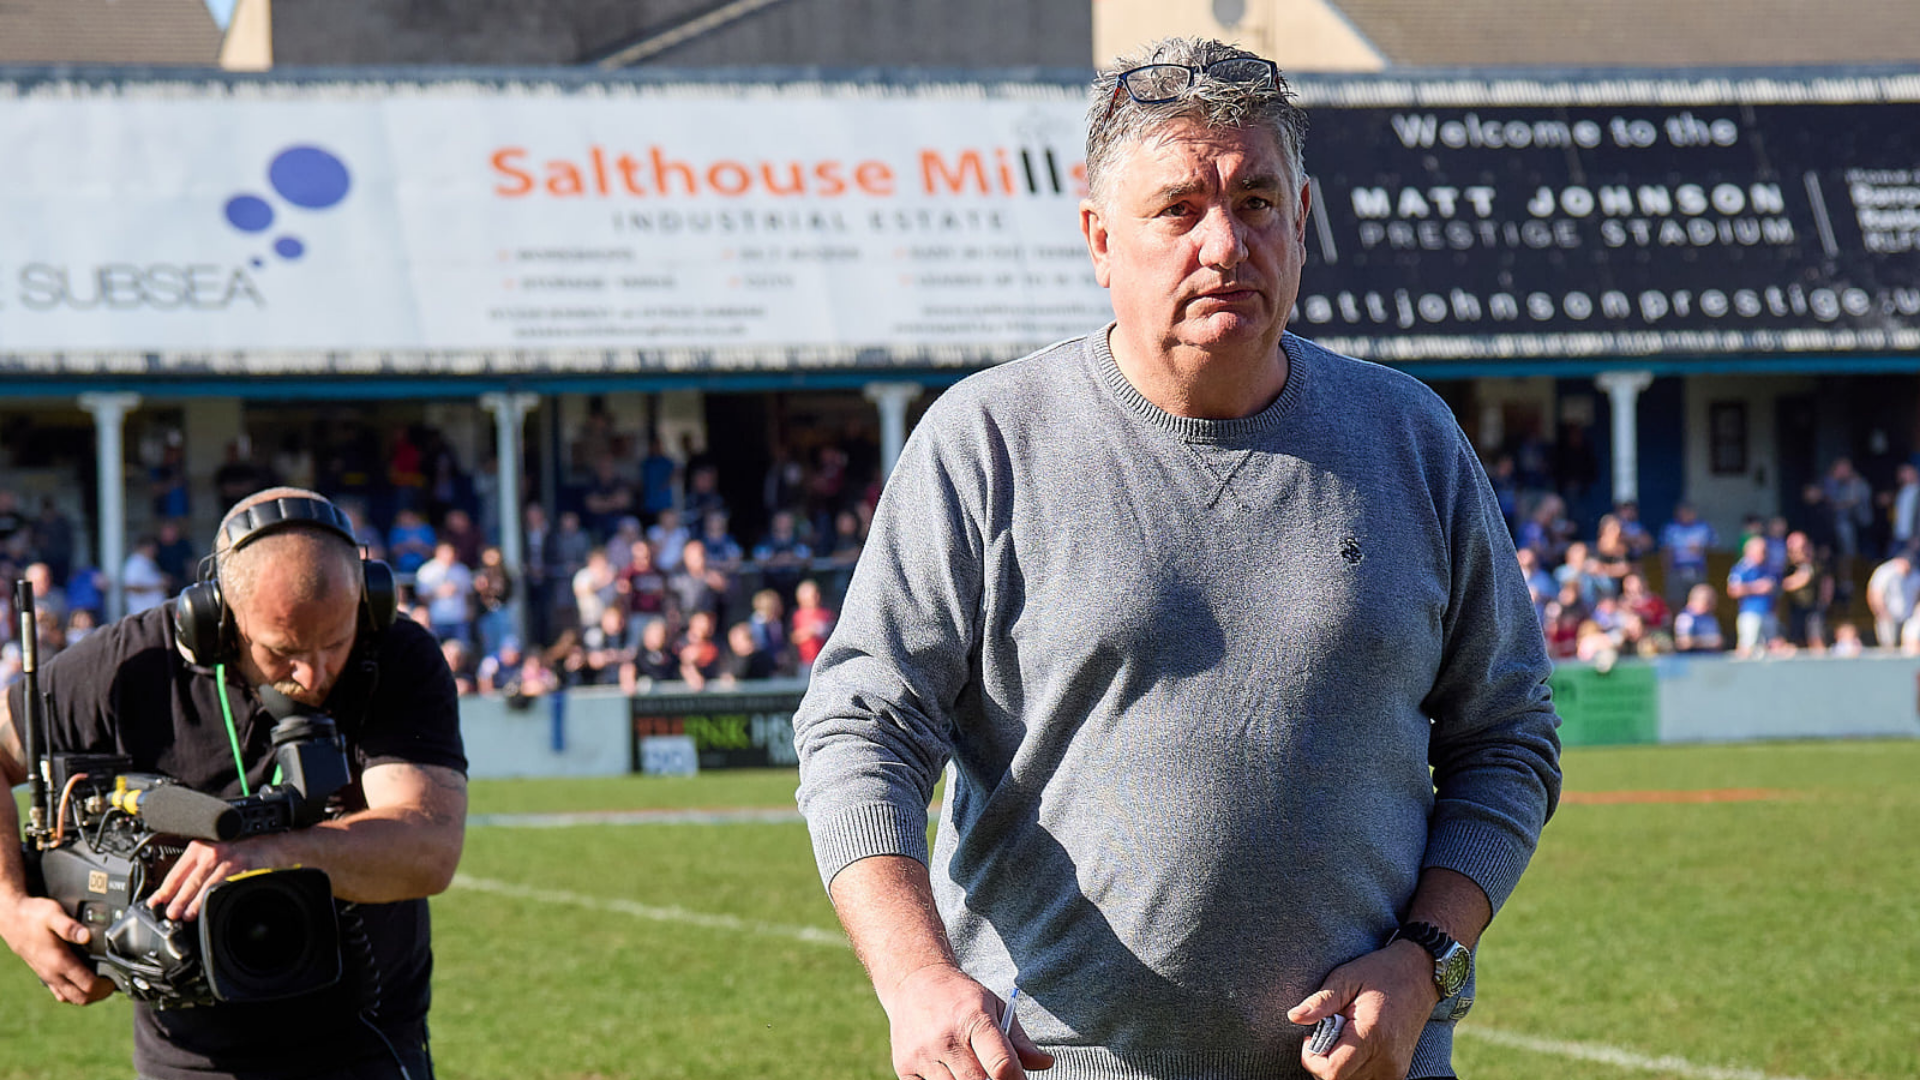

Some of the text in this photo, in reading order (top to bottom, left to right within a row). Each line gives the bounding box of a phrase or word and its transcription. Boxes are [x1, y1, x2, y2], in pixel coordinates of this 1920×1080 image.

[1391, 110, 1738, 149] Welcome to the
[489, 144, 1089, 197] Salthouse Mills
[1351, 183, 1784, 218] MATT JOHNSON
[612, 208, 1004, 234] INDUSTRIAL ESTATE
[1359, 216, 1794, 250] PRESTIGE STADIUM
[18, 261, 267, 311] SUBSEA
